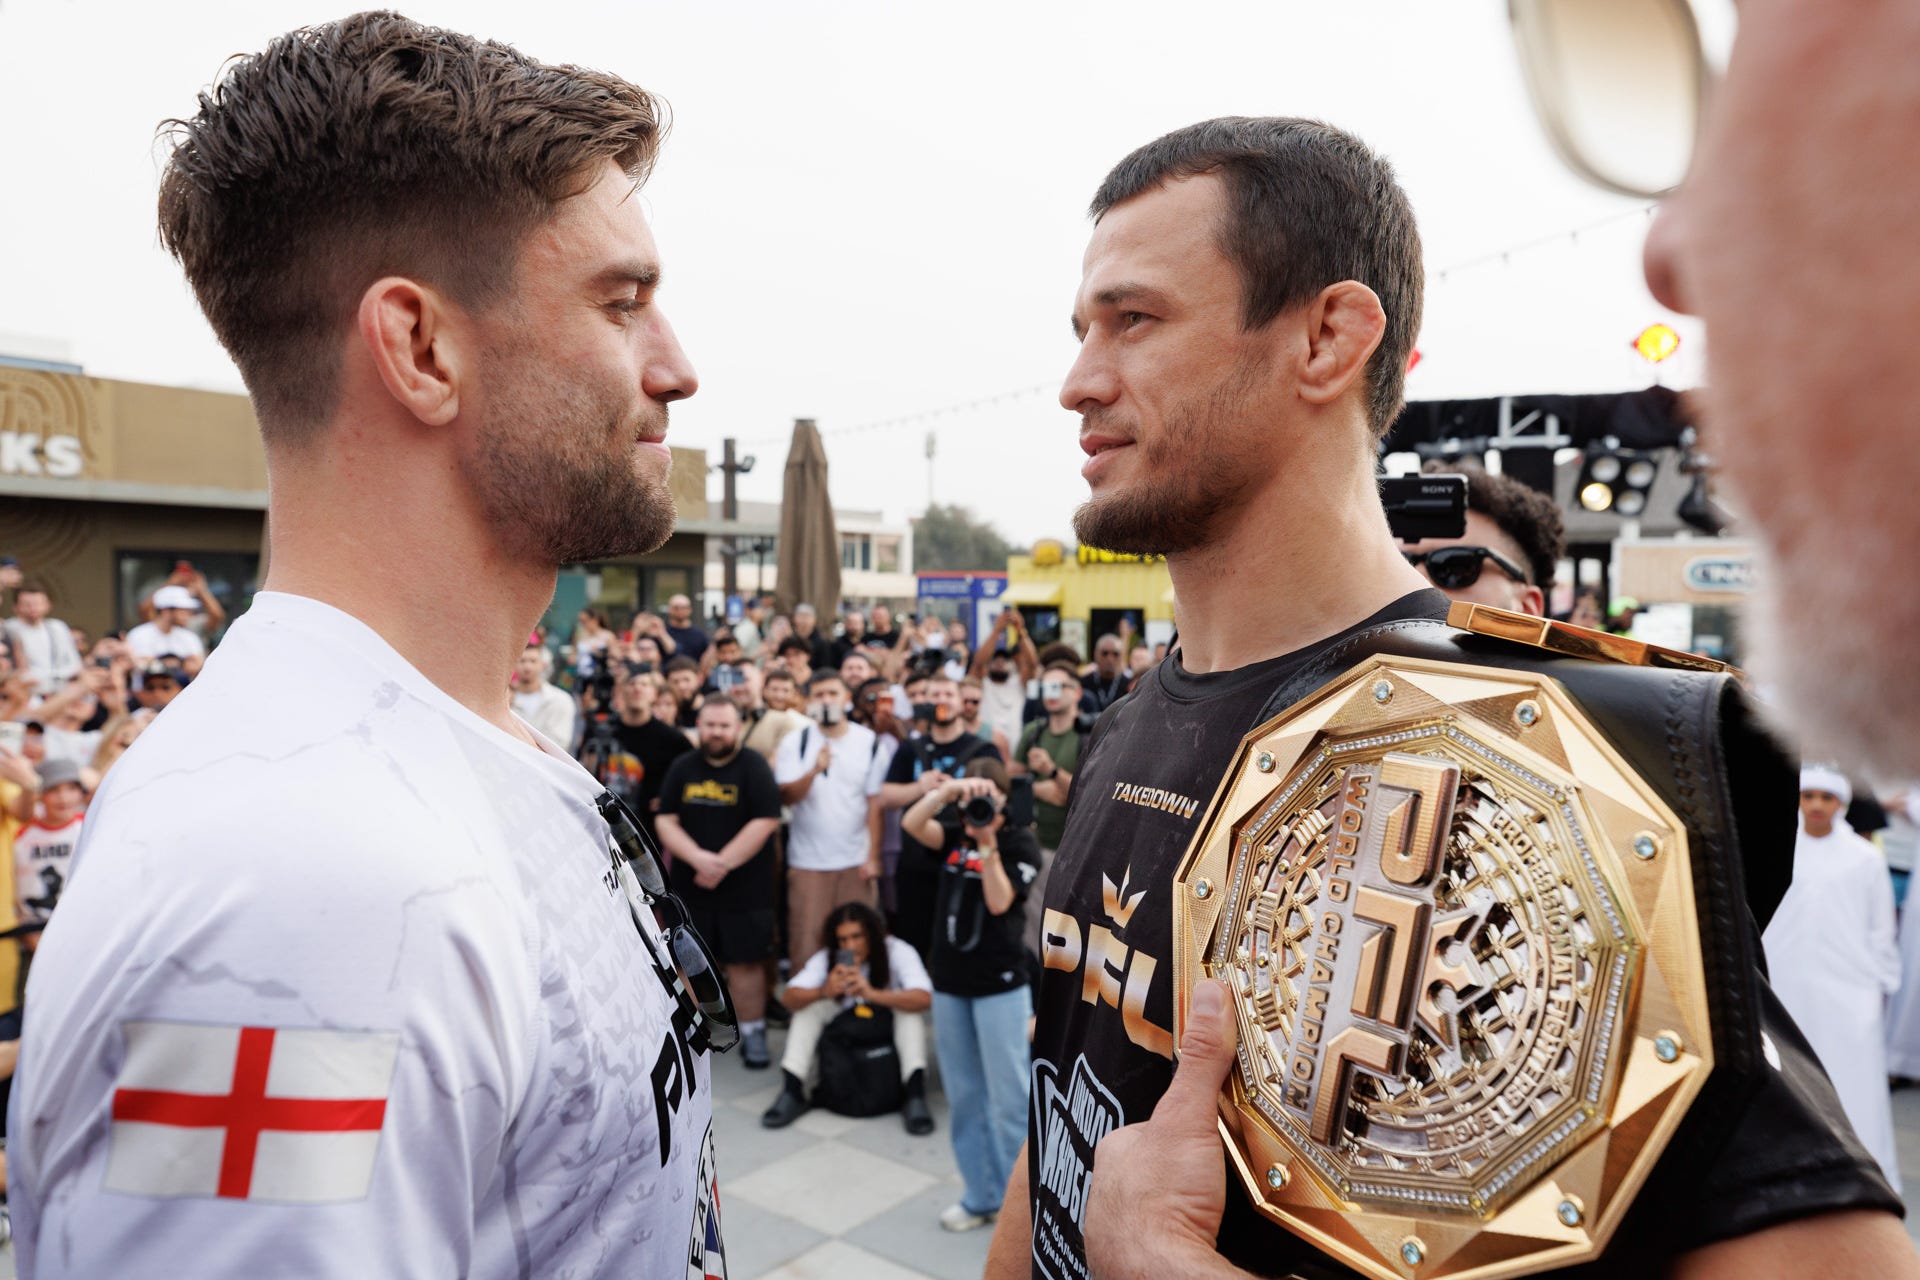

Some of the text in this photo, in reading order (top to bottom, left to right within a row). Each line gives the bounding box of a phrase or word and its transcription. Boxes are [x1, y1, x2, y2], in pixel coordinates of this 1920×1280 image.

[1421, 485, 1454, 494] SONY
[1111, 781, 1200, 819] TAKEDOWN
[1041, 907, 1173, 1061] PFL
[1283, 774, 1373, 1112] WORLD CHAMPION
[1426, 811, 1572, 1150] PROFESSIONAL FIGHTERS LEAGUE
[1071, 1071, 1113, 1148] ШКОЛ
